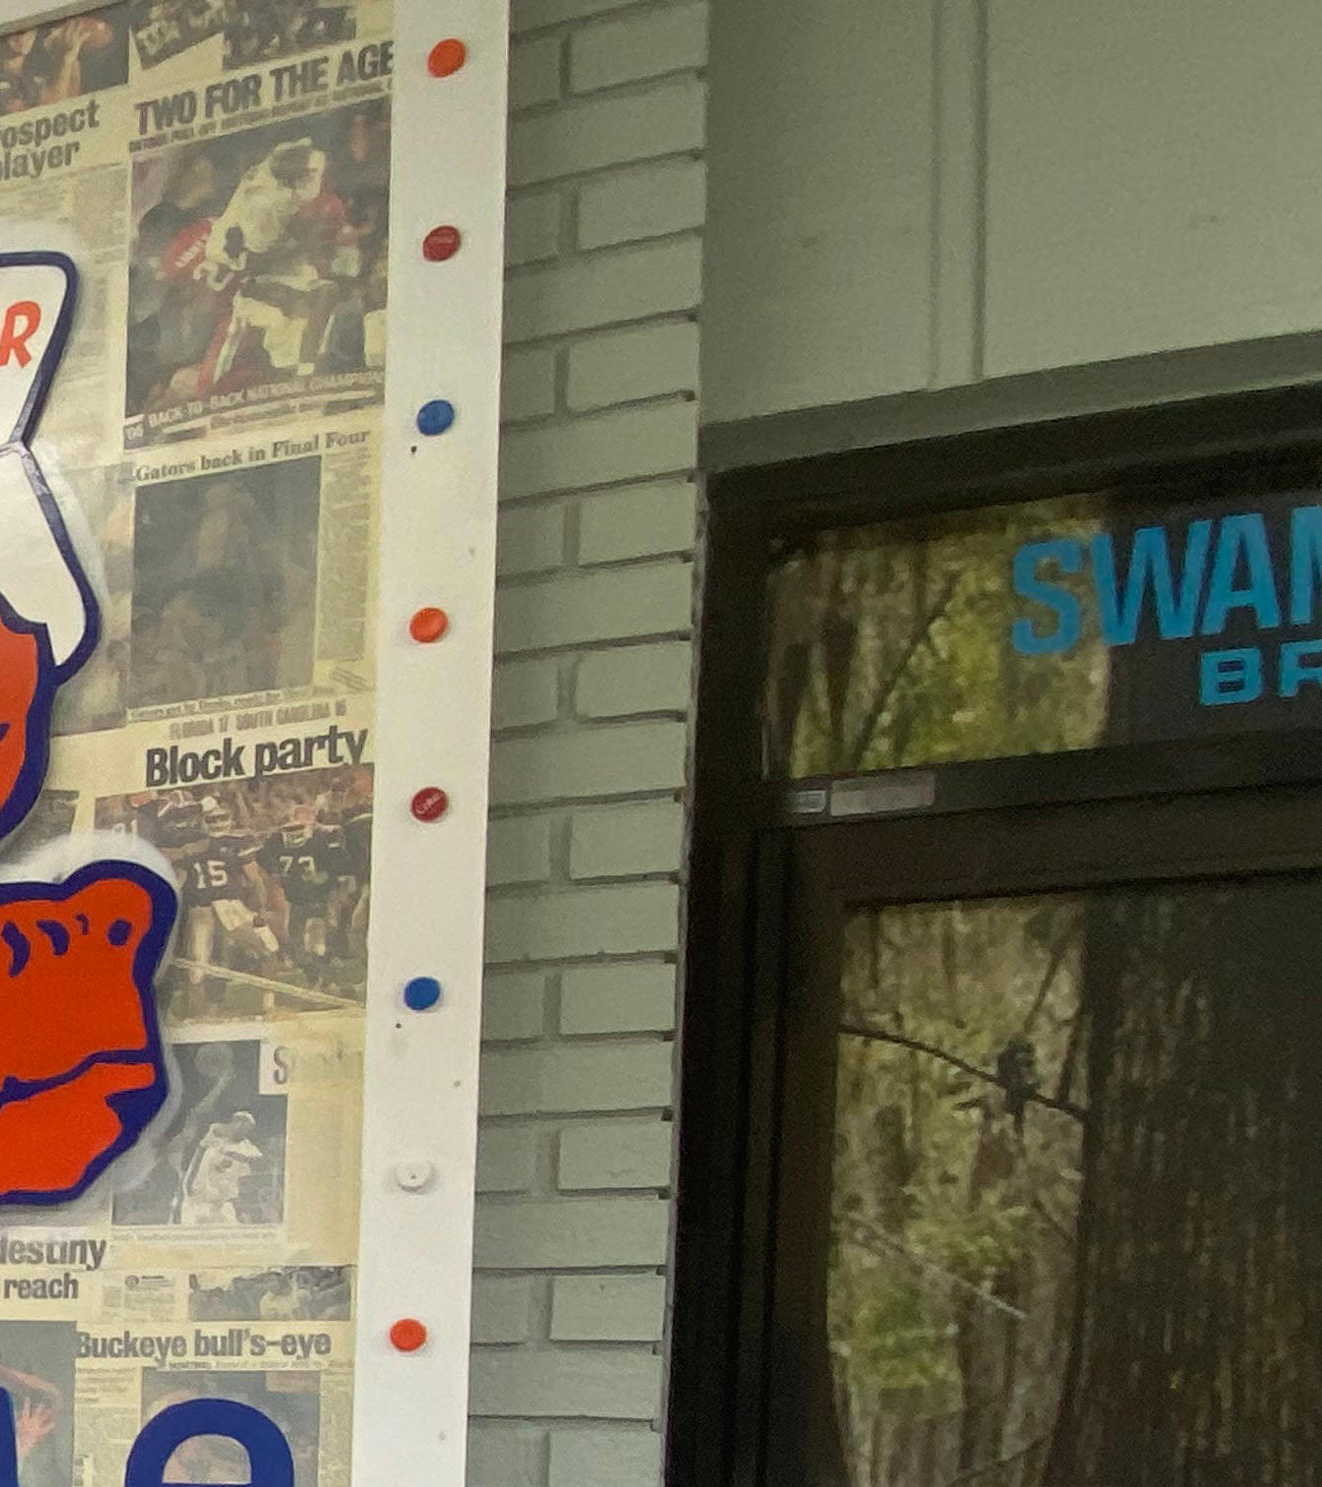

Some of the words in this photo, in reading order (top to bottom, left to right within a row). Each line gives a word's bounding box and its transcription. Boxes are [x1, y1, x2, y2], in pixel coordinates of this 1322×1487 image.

[133, 90, 198, 136] TWO
[204, 73, 262, 120] FOR
[268, 55, 330, 102] THE
[136, 456, 197, 483] Gators
[201, 448, 243, 471] back
[249, 445, 267, 462] in
[272, 435, 319, 459] Final
[325, 430, 371, 449] Four
[145, 737, 246, 788] Block
[254, 724, 369, 778] party
[193, 859, 229, 890] 15
[3, 1273, 79, 1299] reach
[75, 1329, 187, 1368] Buckeye
[194, 1328, 332, 1360] bull's-eye
